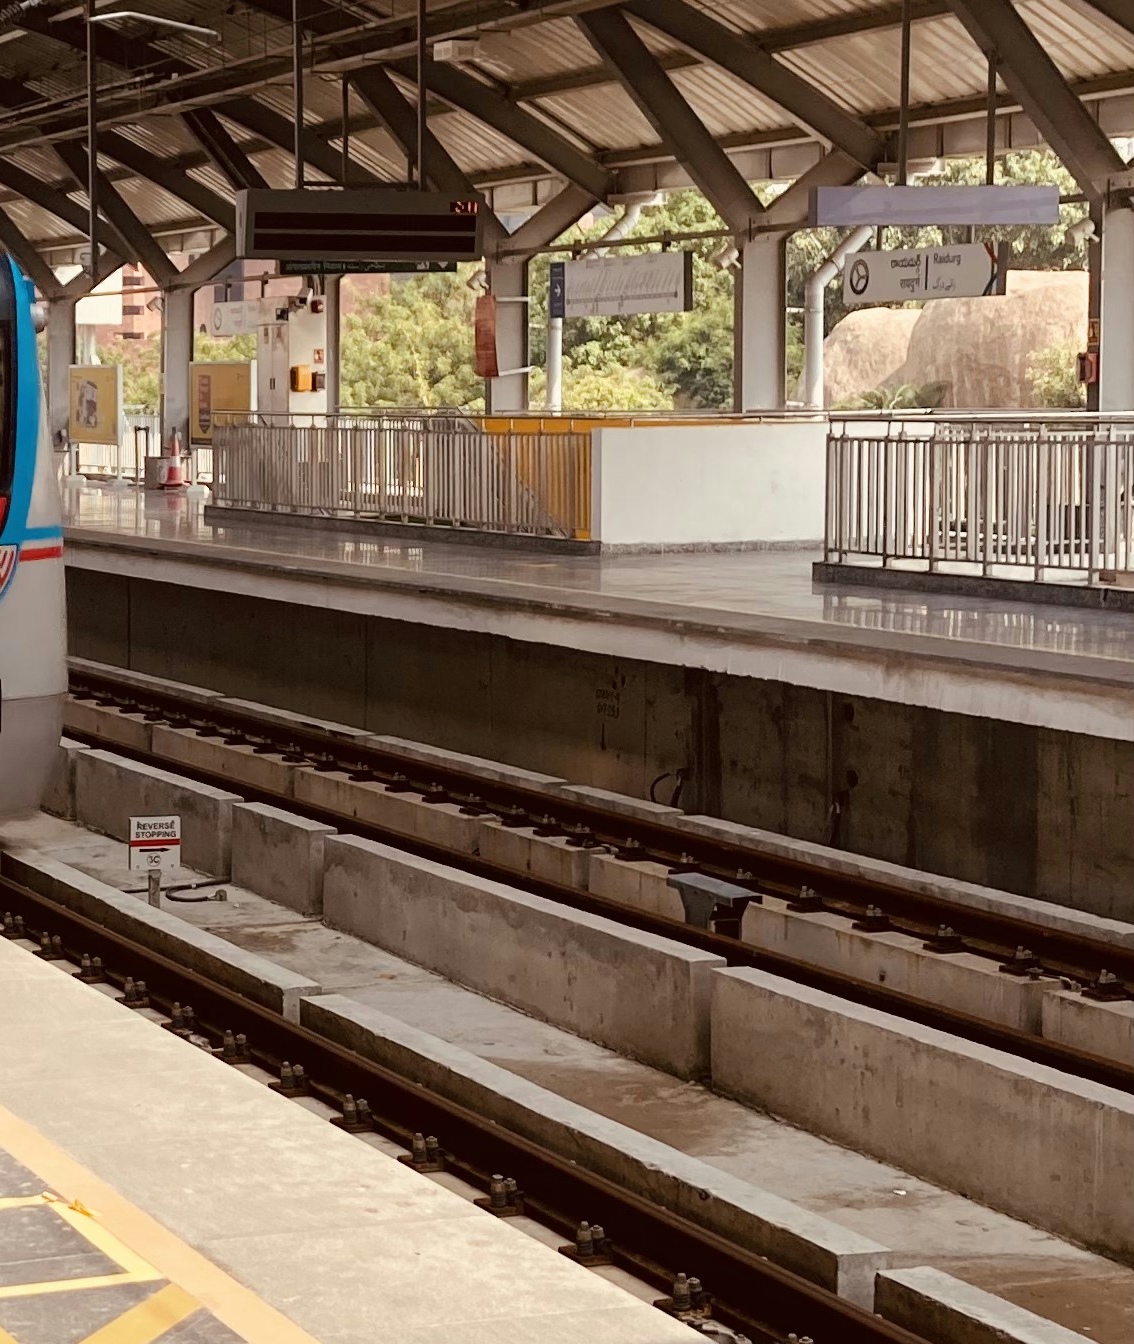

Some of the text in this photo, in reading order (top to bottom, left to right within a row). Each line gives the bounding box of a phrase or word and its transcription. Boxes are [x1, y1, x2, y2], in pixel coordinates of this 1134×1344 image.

[933, 253, 961, 266] Raidurg
[136, 820, 175, 830] REVERSE
[135, 830, 177, 838] STOPPING
[149, 855, 160, 864] 3C
